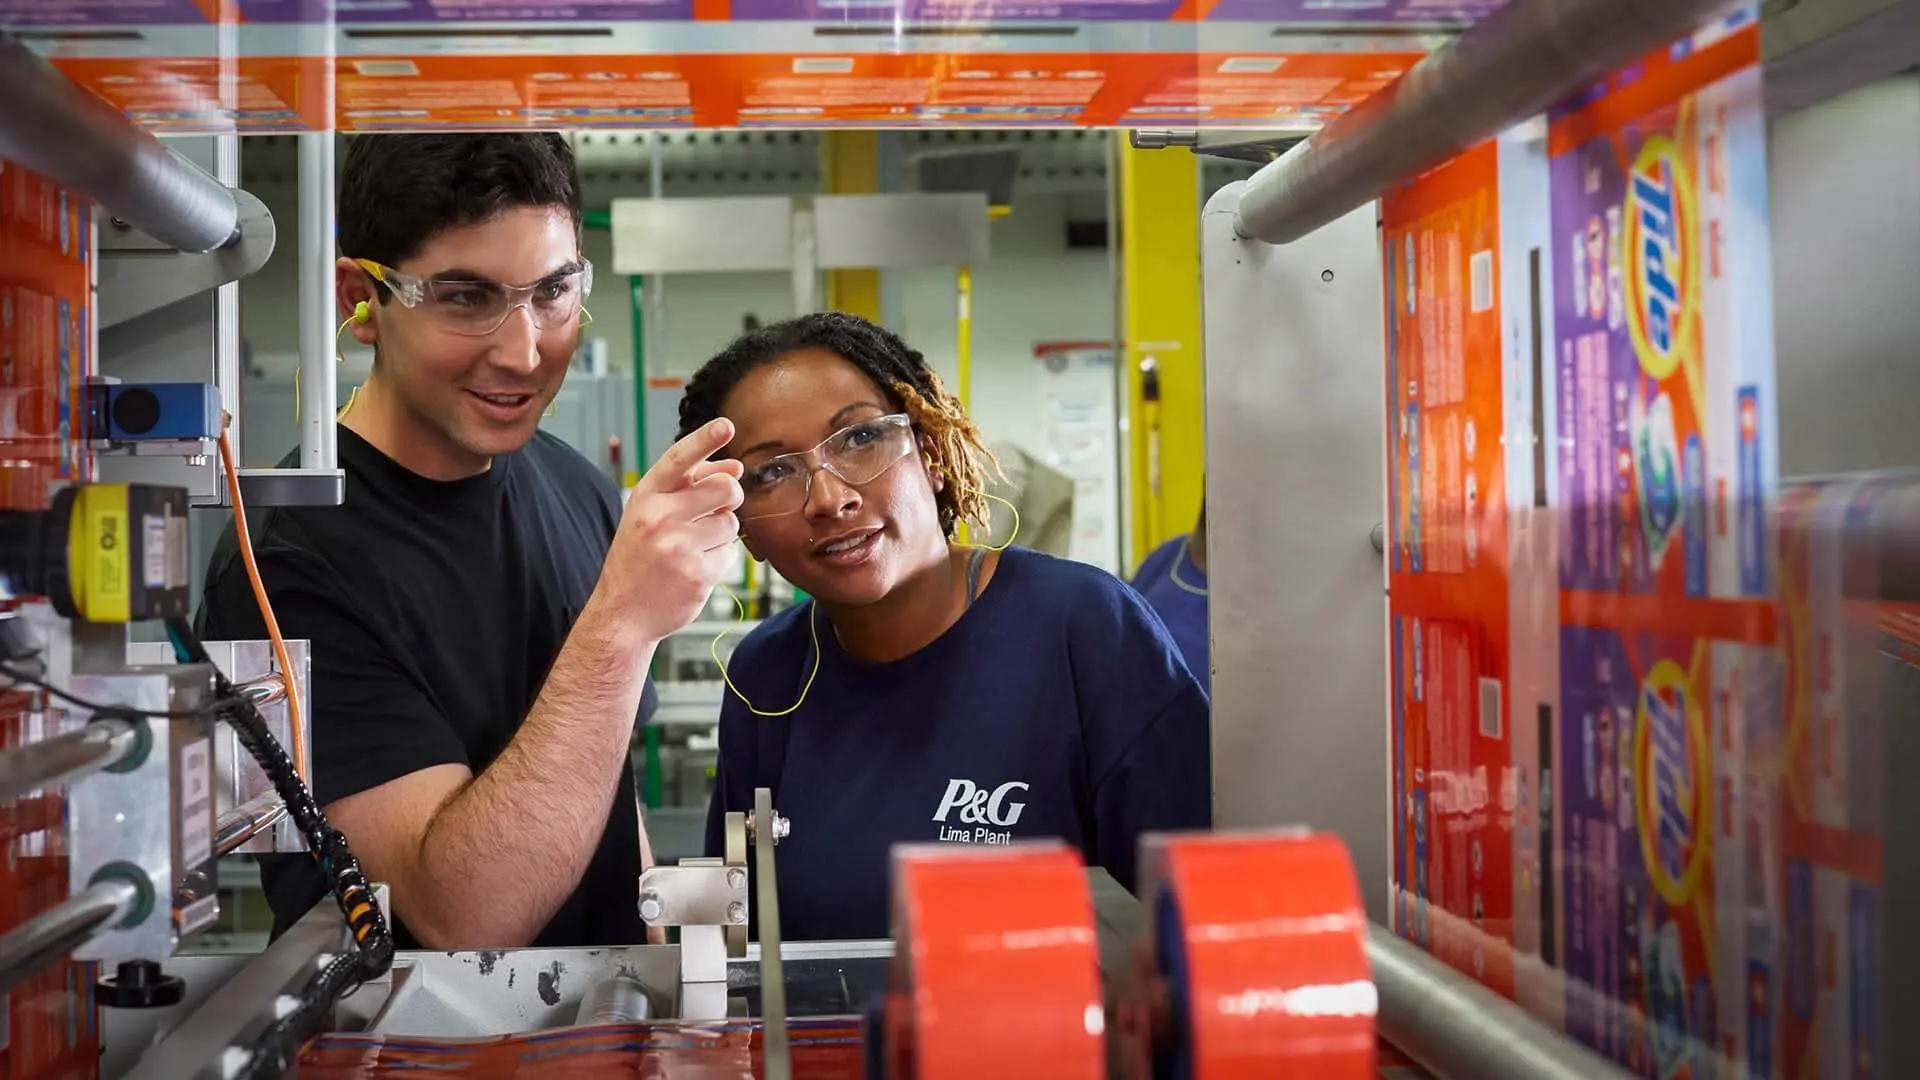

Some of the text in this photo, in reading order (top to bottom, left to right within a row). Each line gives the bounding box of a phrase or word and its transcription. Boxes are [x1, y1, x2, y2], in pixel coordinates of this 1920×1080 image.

[1631, 155, 1682, 358] Tide
[932, 779, 1030, 826] P&G
[940, 825, 1012, 846] Lima Plant
[1644, 681, 1691, 887] Tide
